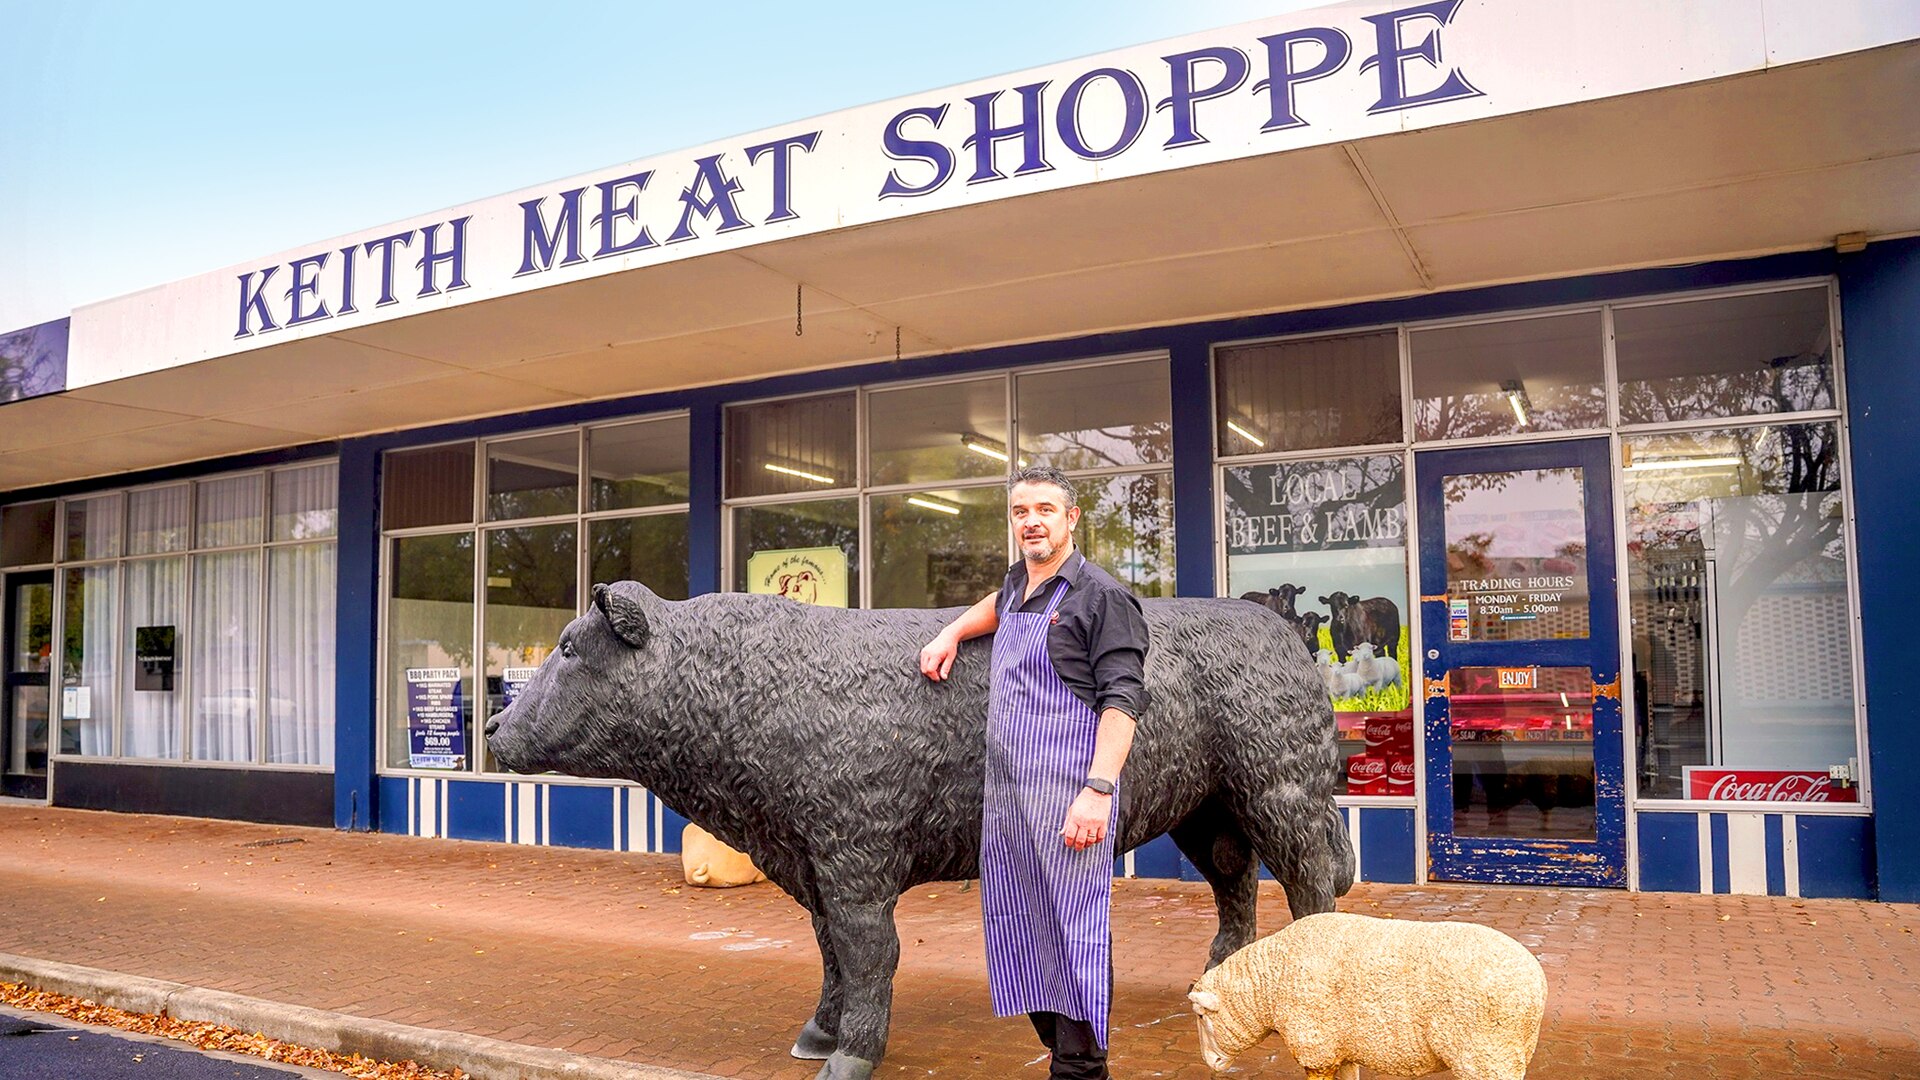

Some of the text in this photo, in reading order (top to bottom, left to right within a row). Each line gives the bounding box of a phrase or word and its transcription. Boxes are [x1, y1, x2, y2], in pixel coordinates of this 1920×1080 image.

[234, 0, 1487, 340] KEITH MEAT SHOPPE
[1269, 470, 1358, 506] LOCAL
[1230, 508, 1401, 548] BEEF & LAMB
[790, 555, 800, 564] the
[1460, 576, 1575, 591] TRADING HOURS
[1475, 594, 1519, 605] MONDAY
[1529, 593, 1562, 603] FRIDAY
[1480, 605, 1513, 615] 8.30am
[1523, 604, 1559, 615] 5.00pm
[410, 670, 458, 680] BBQ PARTY PACK
[1502, 672, 1530, 685] ENJOY
[1349, 762, 1385, 774] Coca-Cola
[1391, 761, 1414, 774] Coca-Co
[1708, 774, 1831, 802] Coca-Cola
